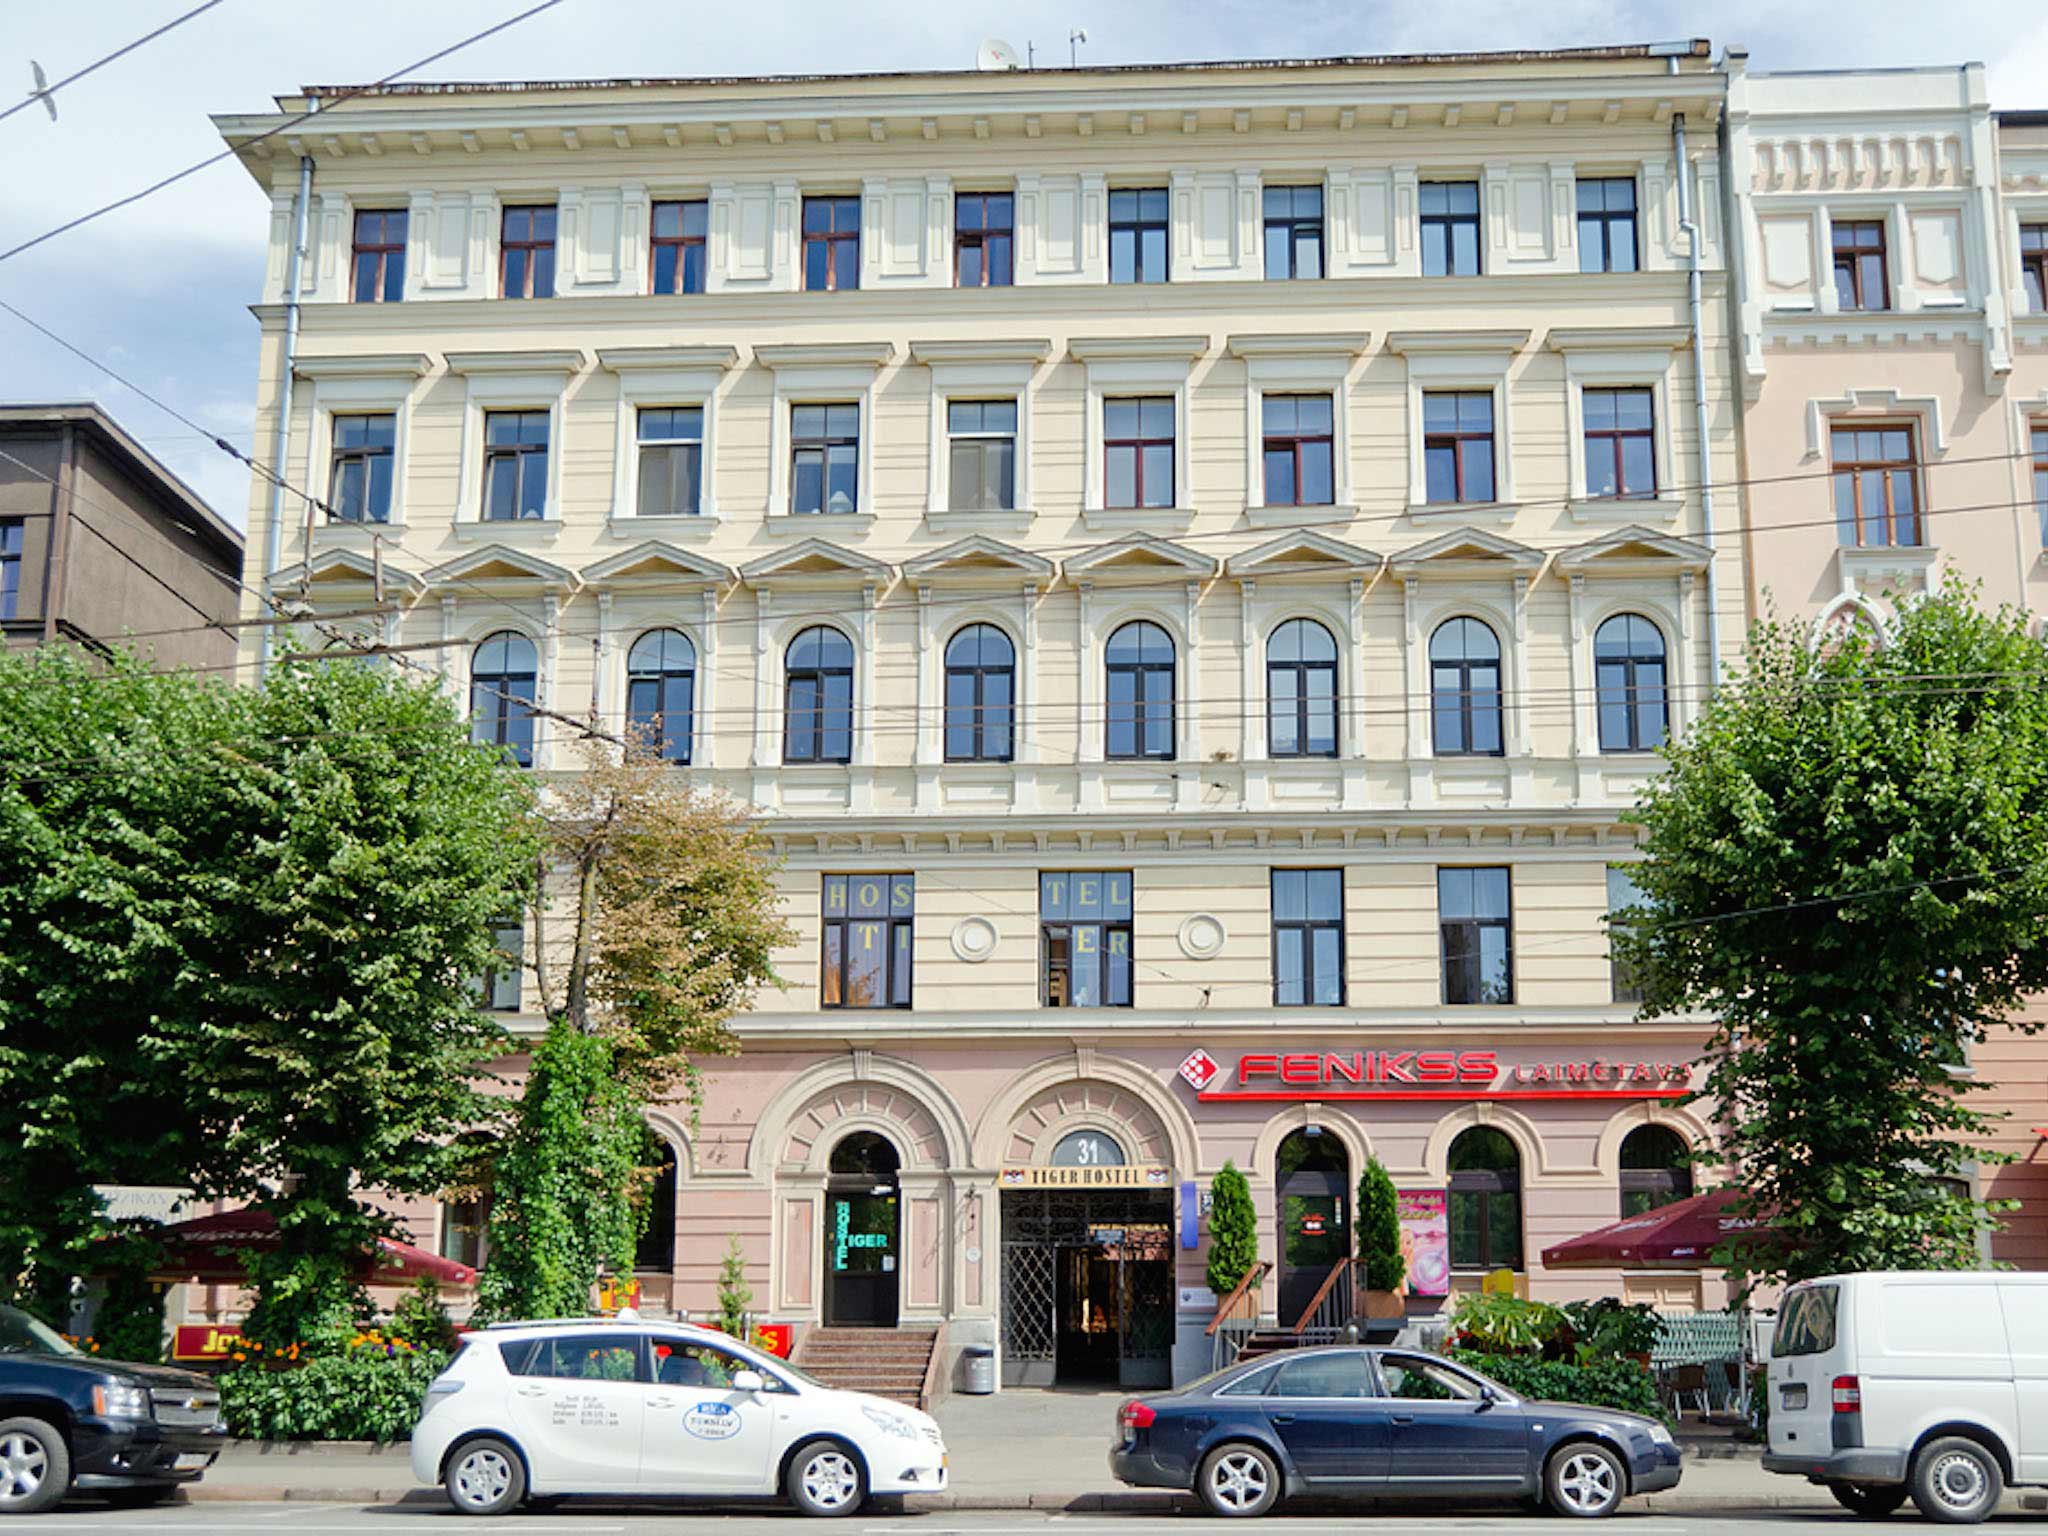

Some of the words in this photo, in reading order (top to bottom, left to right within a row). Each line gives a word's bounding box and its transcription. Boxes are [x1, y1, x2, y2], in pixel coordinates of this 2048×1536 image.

[829, 884, 912, 909] HOS
[1045, 880, 1129, 905] TEL
[1239, 1052, 1499, 1083] FENIKSS
[1078, 1138, 1098, 1164] 31
[1033, 1170, 1077, 1184] TIGER
[1084, 1169, 1138, 1184] HOSTEL
